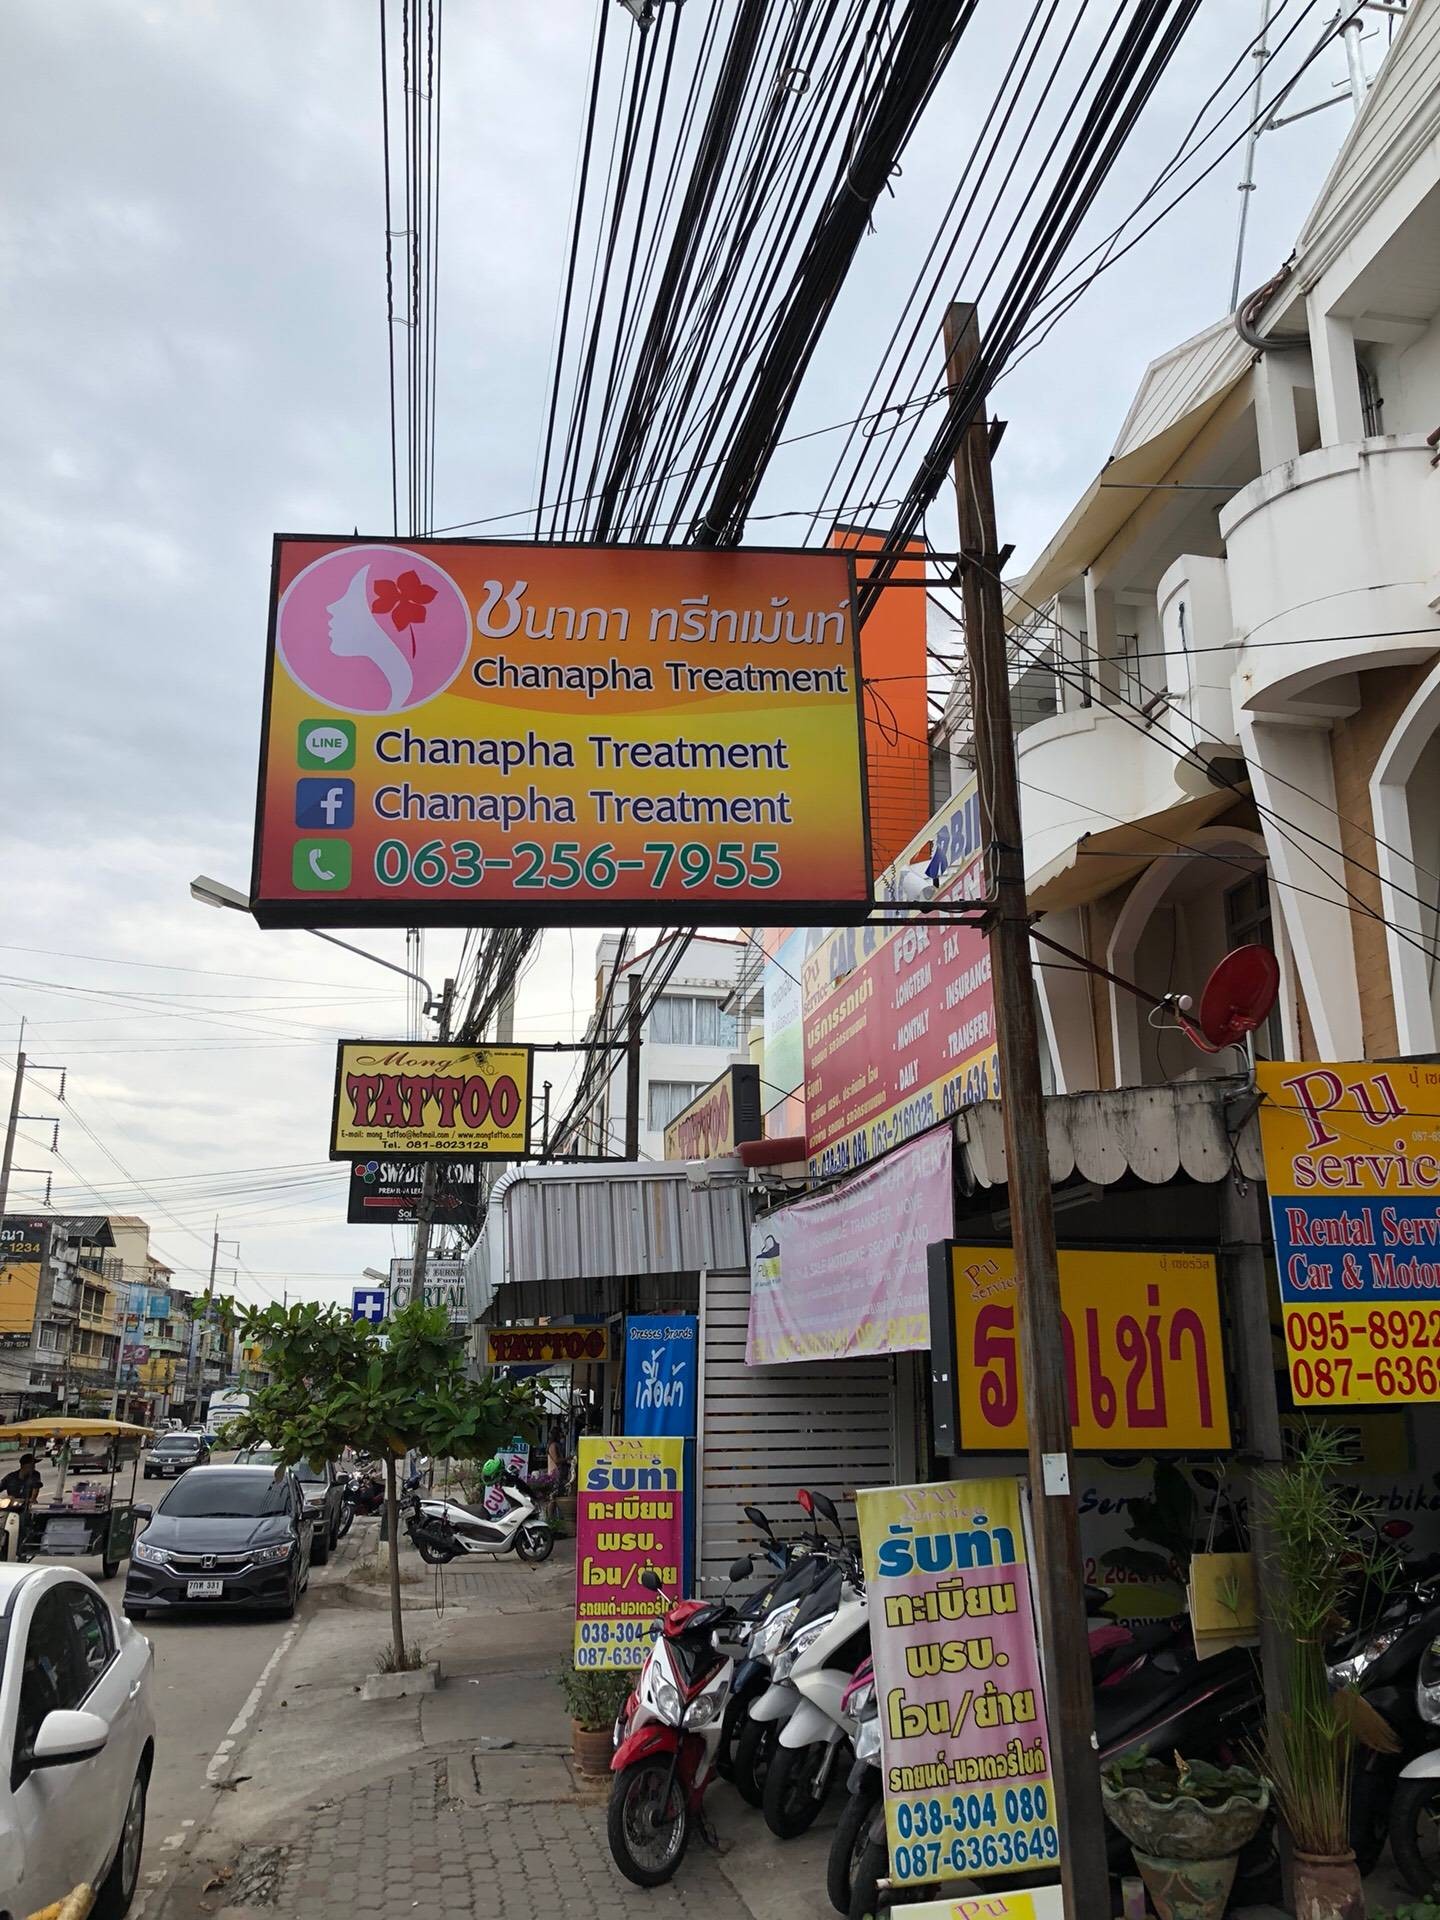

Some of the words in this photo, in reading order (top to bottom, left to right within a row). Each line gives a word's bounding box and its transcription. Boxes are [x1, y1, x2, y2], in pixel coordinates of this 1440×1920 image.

[476, 579, 630, 641] ชนาภา
[648, 595, 852, 645] ทรีทเม้นท์
[472, 656, 654, 699] Chanapha
[664, 661, 849, 693] Treatment
[311, 737, 343, 749] LINE
[374, 728, 576, 776] Chanapha
[587, 735, 790, 769] Treatment
[373, 782, 577, 832] Chanapha
[588, 790, 793, 824] Treatment
[373, 838, 783, 890] 063-256-7955
[943, 931, 960, 965] TAX
[945, 952, 992, 1010] INSURANCE
[897, 1007, 930, 1052] MONTHLY
[948, 1002, 996, 1059] TRANSFER/
[356, 1051, 453, 1073] Mong
[900, 1057, 919, 1092] DAILY
[345, 1071, 523, 1129] TATTOO
[1283, 1068, 1407, 1150] Pu
[341, 1129, 364, 1138] E-mail:
[381, 1140, 401, 1149] Tel.
[406, 1140, 489, 1150] 081-8023128
[0, 1242, 41, 1253] -1234
[1285, 1207, 1376, 1248] Rental
[1380, 1206, 1440, 1248] Serv
[963, 1258, 1001, 1288] Pu
[1287, 1253, 1334, 1291] Car
[1341, 1252, 1365, 1290] &
[490, 1331, 605, 1361] TATTOO
[664, 1327, 693, 1341] Brands
[974, 1283, 1213, 1429] รเช่า
[1292, 1354, 1440, 1399] 087-636
[635, 1347, 686, 1409] เสื้อผ้า
[606, 1439, 643, 1453] Pu
[586, 1459, 677, 1491] รับทำ
[588, 1495, 674, 1520] ทะเบียน
[597, 1532, 664, 1552] พรบ.
[878, 1514, 1016, 1578] รับทำ
[884, 1577, 1018, 1628] ทะเบียน
[581, 1622, 643, 1643] 038-304
[905, 1636, 1010, 1678] พรบ.
[887, 1681, 1037, 1740] โอน/ย้าย
[896, 1792, 998, 1840] 038-304
[1004, 1784, 1048, 1825] 080
[894, 1825, 1059, 1880] 087-6363649
